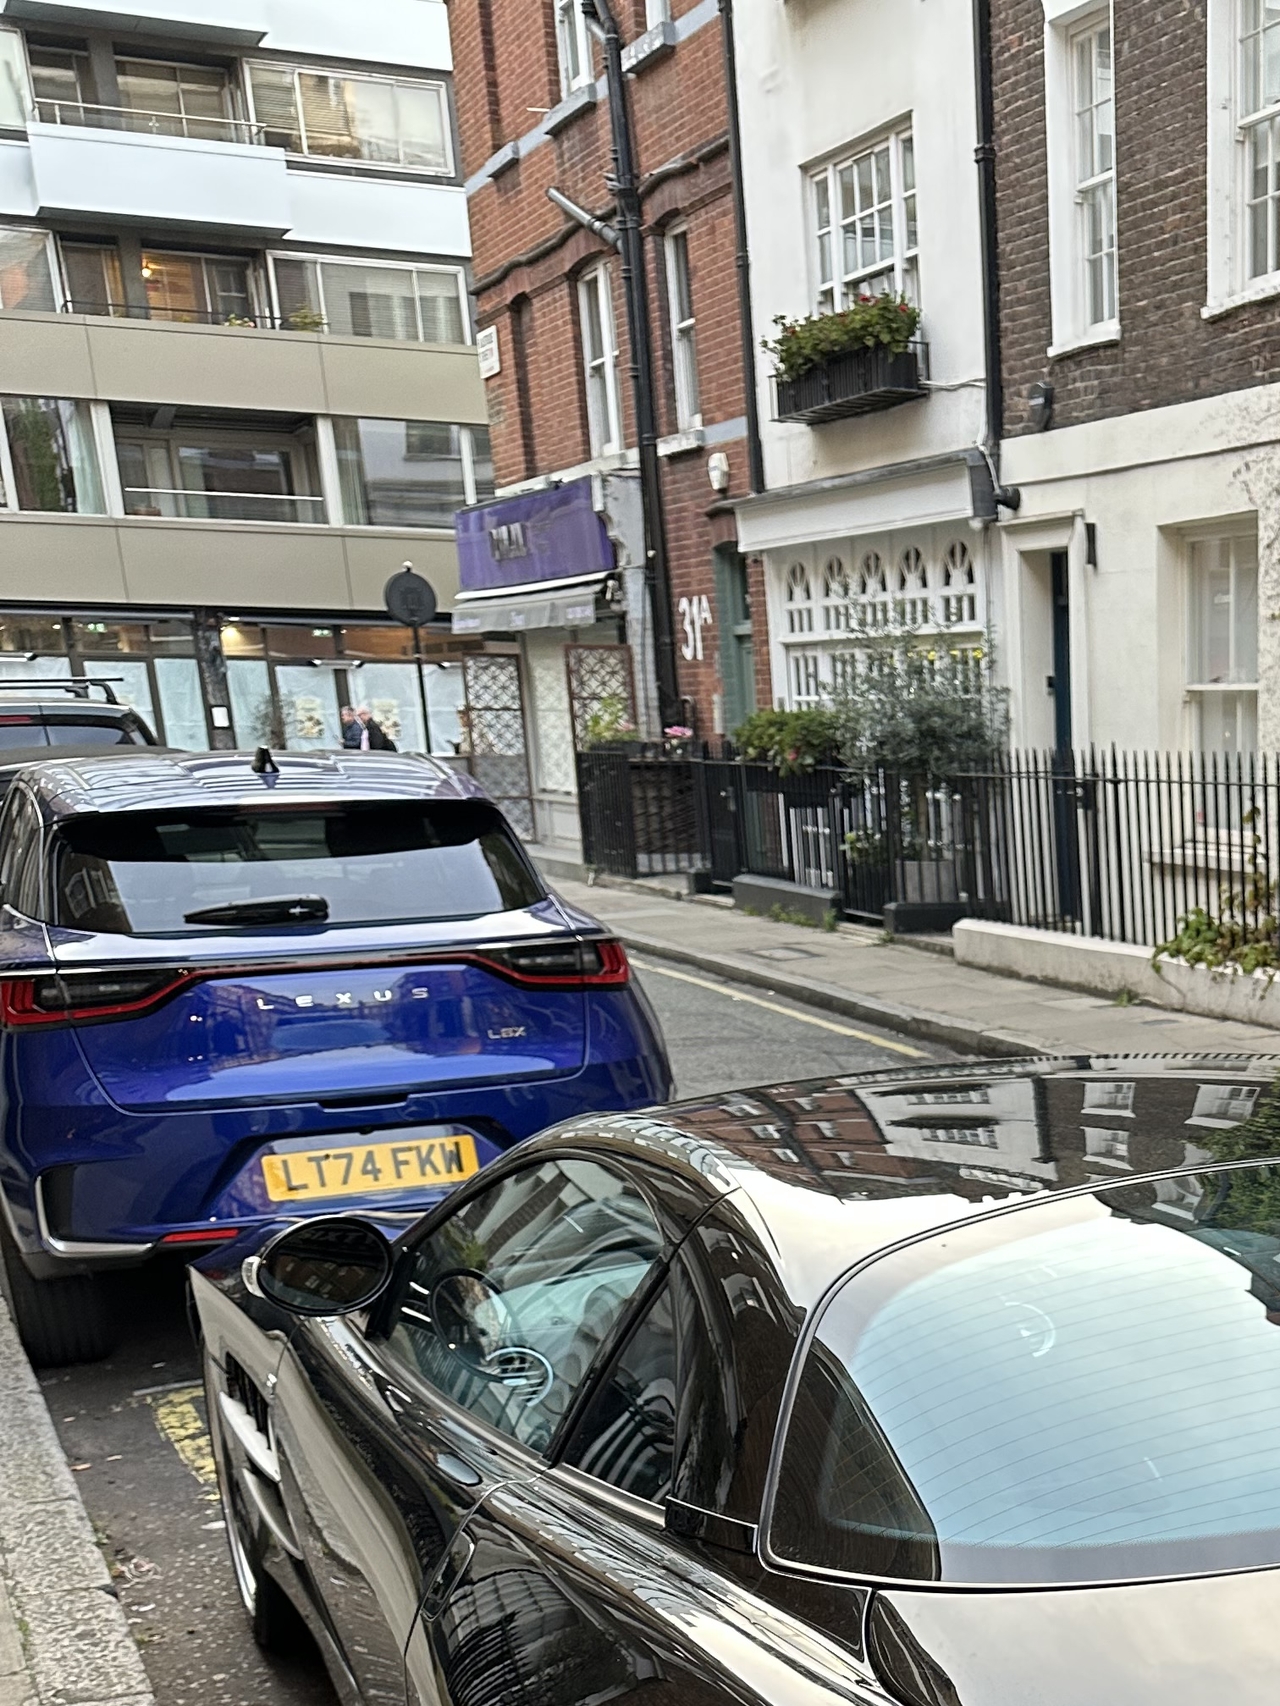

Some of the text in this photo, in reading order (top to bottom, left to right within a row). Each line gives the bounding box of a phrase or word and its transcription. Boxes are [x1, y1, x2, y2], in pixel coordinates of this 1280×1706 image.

[256, 986, 429, 1010] LEXUS
[487, 1025, 527, 1040] LBX
[281, 1141, 465, 1192] LT74 FKW
